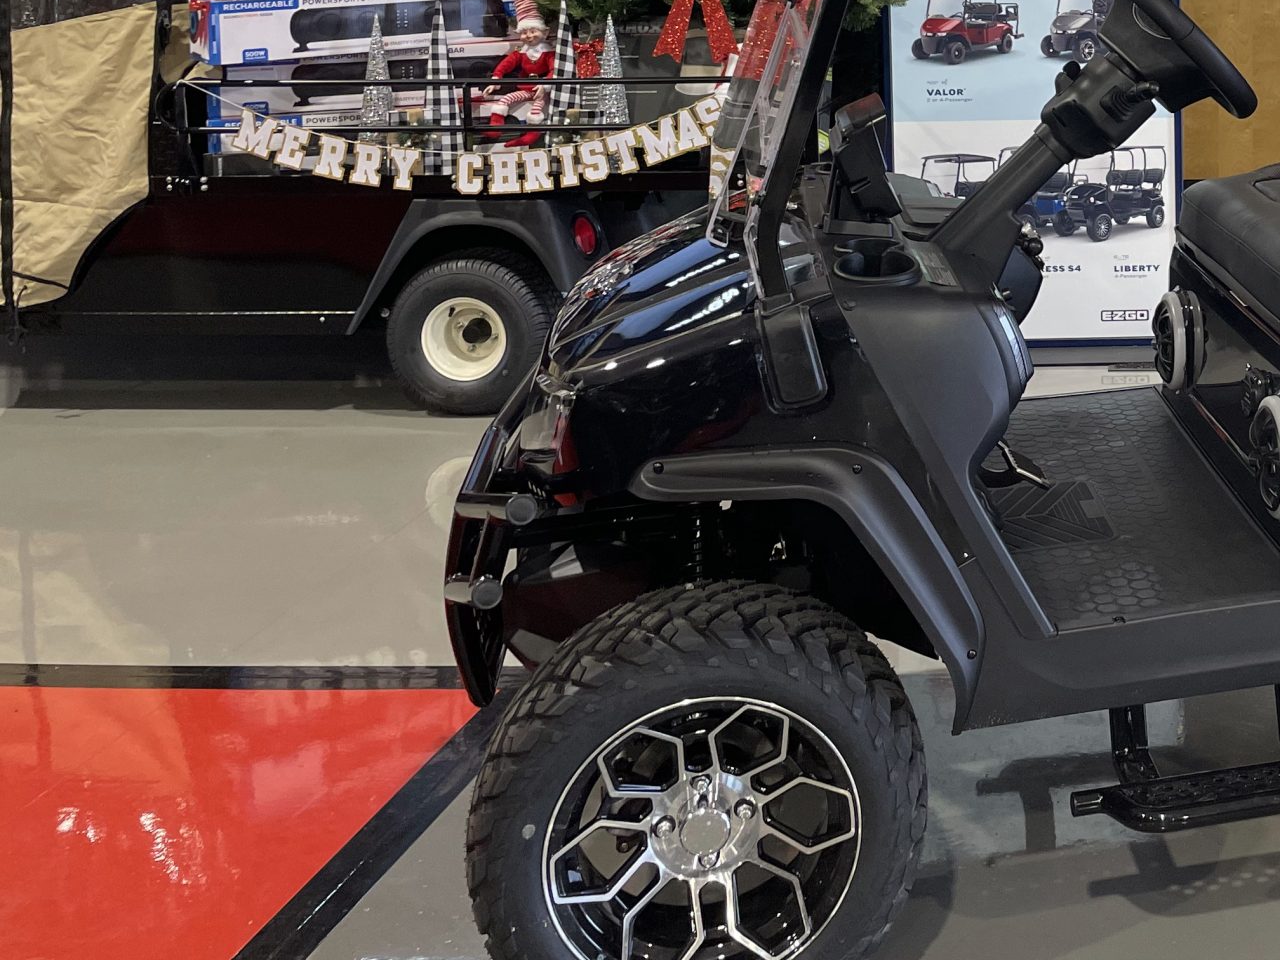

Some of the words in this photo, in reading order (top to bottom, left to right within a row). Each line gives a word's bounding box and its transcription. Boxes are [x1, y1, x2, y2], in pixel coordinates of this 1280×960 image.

[222, 0, 295, 12] RECHARGEABLE
[926, 88, 965, 96] VALOR
[231, 107, 422, 191] MERRY
[456, 93, 722, 195] CHRISTMAS
[1067, 264, 1082, 272] S4
[1113, 264, 1160, 272] LIBERTY
